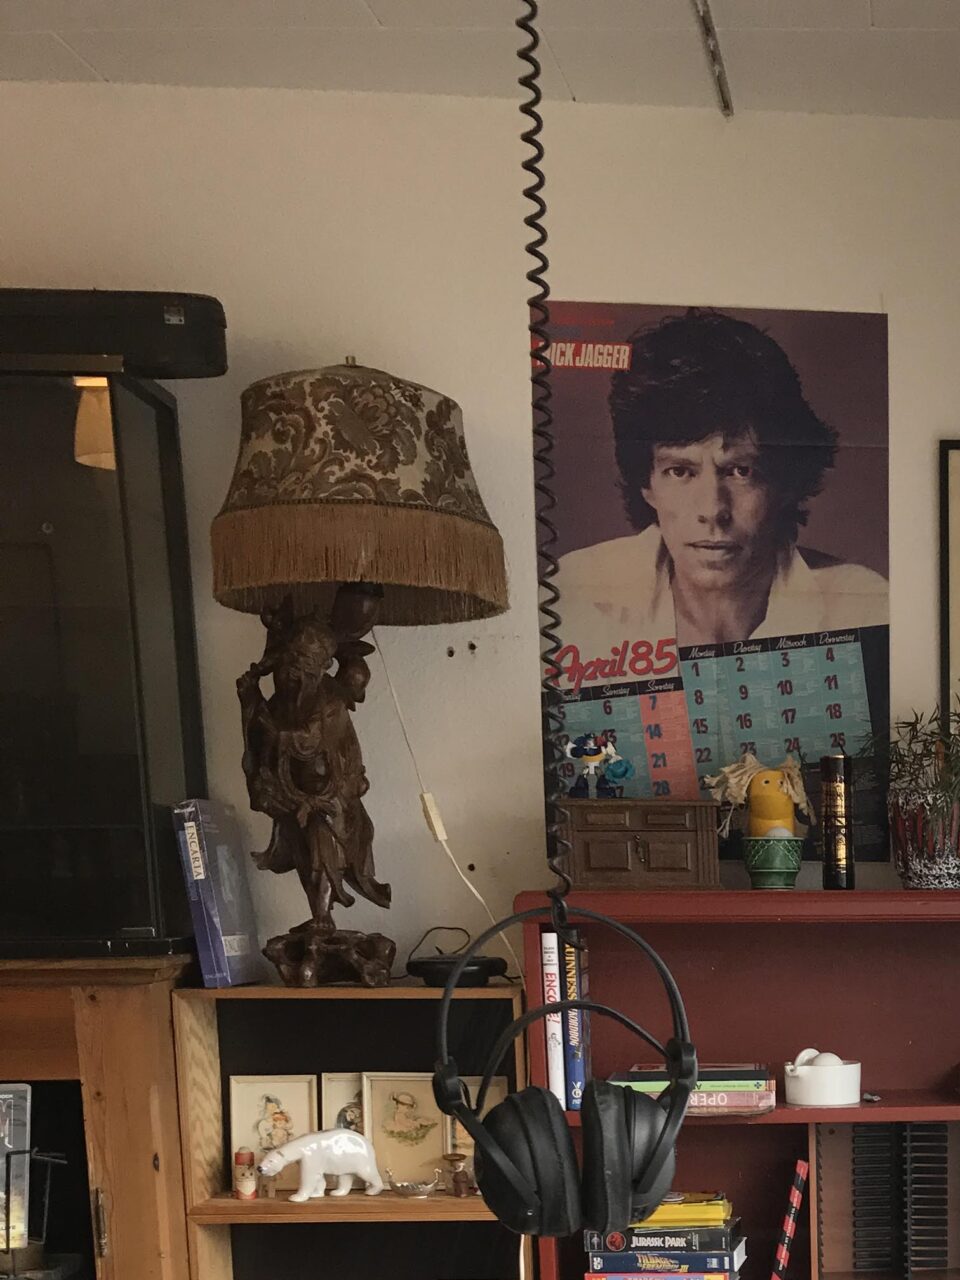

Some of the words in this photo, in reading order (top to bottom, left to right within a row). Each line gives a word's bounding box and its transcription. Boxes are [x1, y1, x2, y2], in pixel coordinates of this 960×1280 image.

[575, 343, 630, 369] JAGGER
[545, 640, 629, 694] April
[691, 662, 700, 677] 1
[736, 657, 745, 672] 2
[781, 652, 790, 667] 3
[825, 647, 835, 662] 4
[694, 689, 704, 705] 8
[739, 685, 748, 700] 9
[777, 680, 793, 696] 10
[824, 674, 838, 690] 11
[603, 700, 612, 715] 6
[648, 695, 657, 710] 7
[693, 718, 709, 734] 15
[736, 713, 752, 729] 16
[781, 708, 797, 724] 17
[826, 703, 842, 720] 18
[646, 724, 662, 739] 14
[652, 753, 667, 768] 21
[695, 747, 712, 763] 22
[785, 737, 800, 752] 24
[830, 732, 845, 748] 25
[186, 825, 203, 878] ENCARTA
[631, 1236, 664, 1248] JURASSIC
[665, 1236, 687, 1248] PARK
